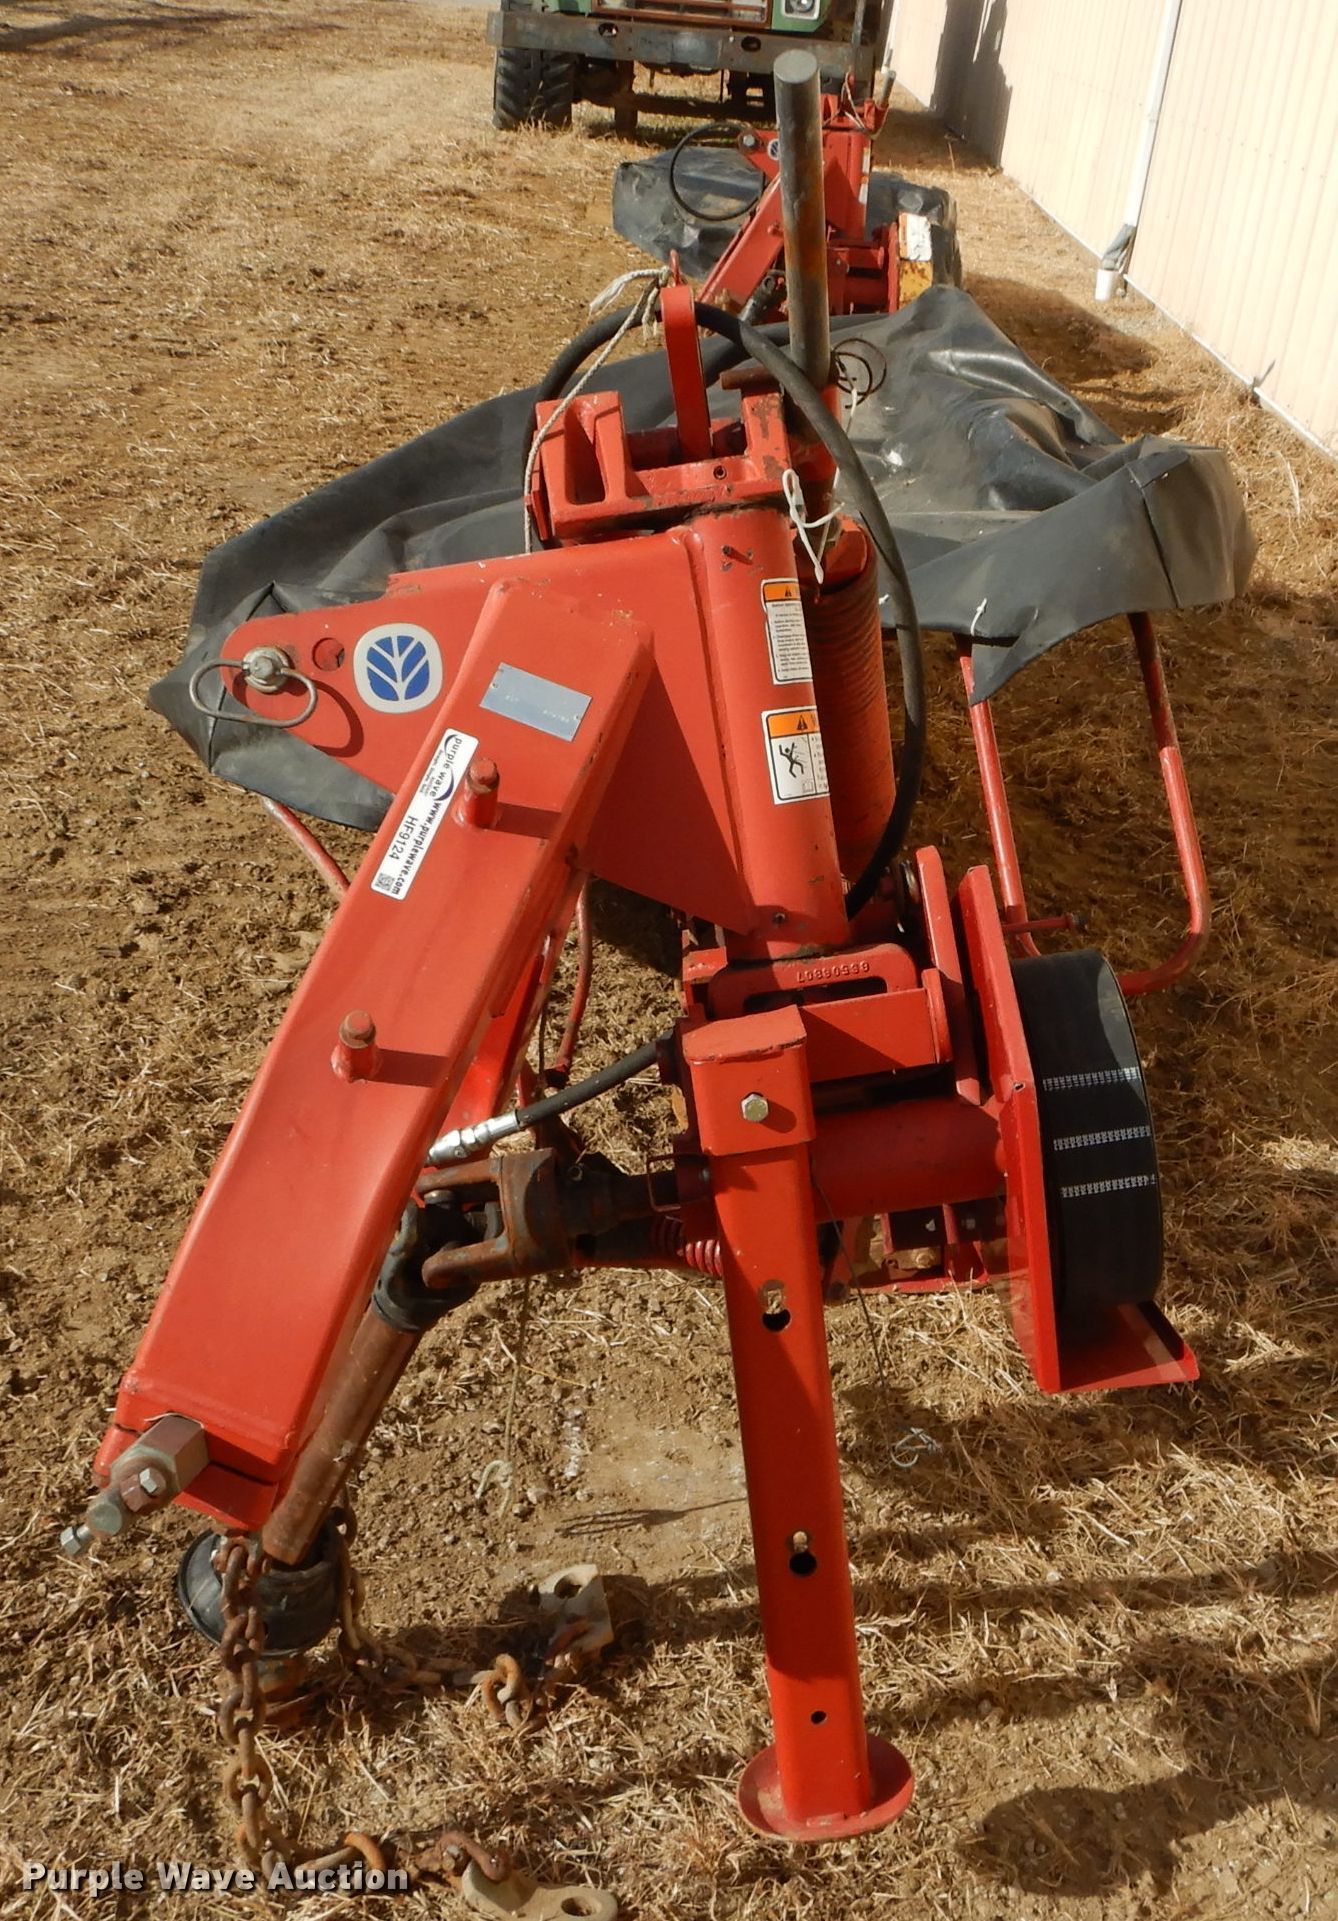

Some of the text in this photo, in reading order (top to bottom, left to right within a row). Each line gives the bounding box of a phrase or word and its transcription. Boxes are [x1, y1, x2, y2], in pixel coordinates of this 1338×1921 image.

[442, 736, 463, 769] purple
[429, 771, 447, 798] wave
[389, 815, 418, 860] HF9124
[392, 802, 442, 895] www.purplewave.com
